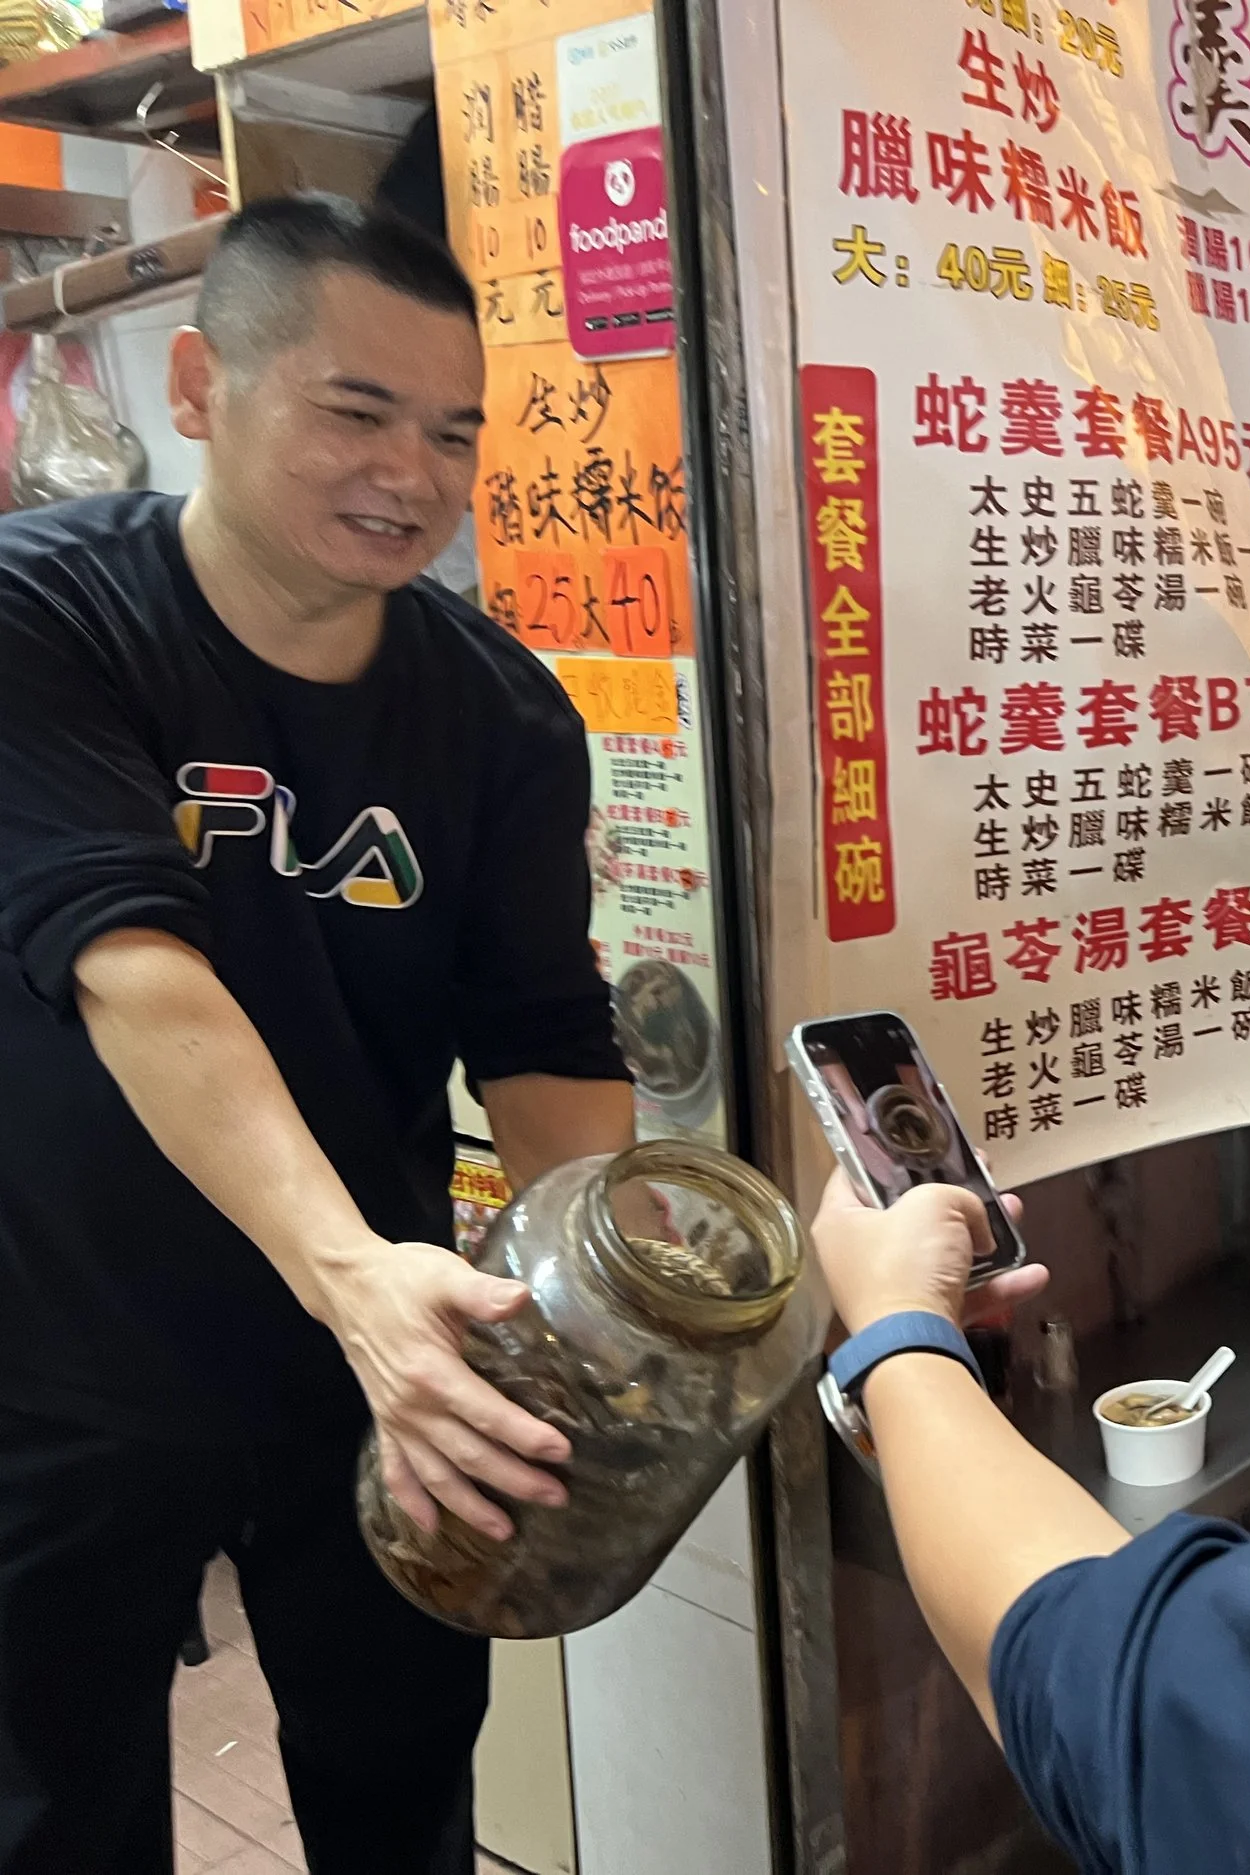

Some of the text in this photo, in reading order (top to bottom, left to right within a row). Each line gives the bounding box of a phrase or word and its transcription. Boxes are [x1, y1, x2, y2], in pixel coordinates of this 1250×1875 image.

[957, 27, 1061, 133] 生炒
[839, 108, 1149, 260] 臘味糯米飯
[569, 207, 669, 255] foodpand
[968, 474, 1229, 526] 太史五蛇羹一碗
[968, 572, 1249, 617] 老火龜苓湯一碗
[812, 405, 886, 906] 套餐全部細碗
[968, 618, 1146, 664] 時菜一碟
[974, 846, 1147, 902] 時菜一碟
[983, 1071, 1149, 1142] 時菜一碟
